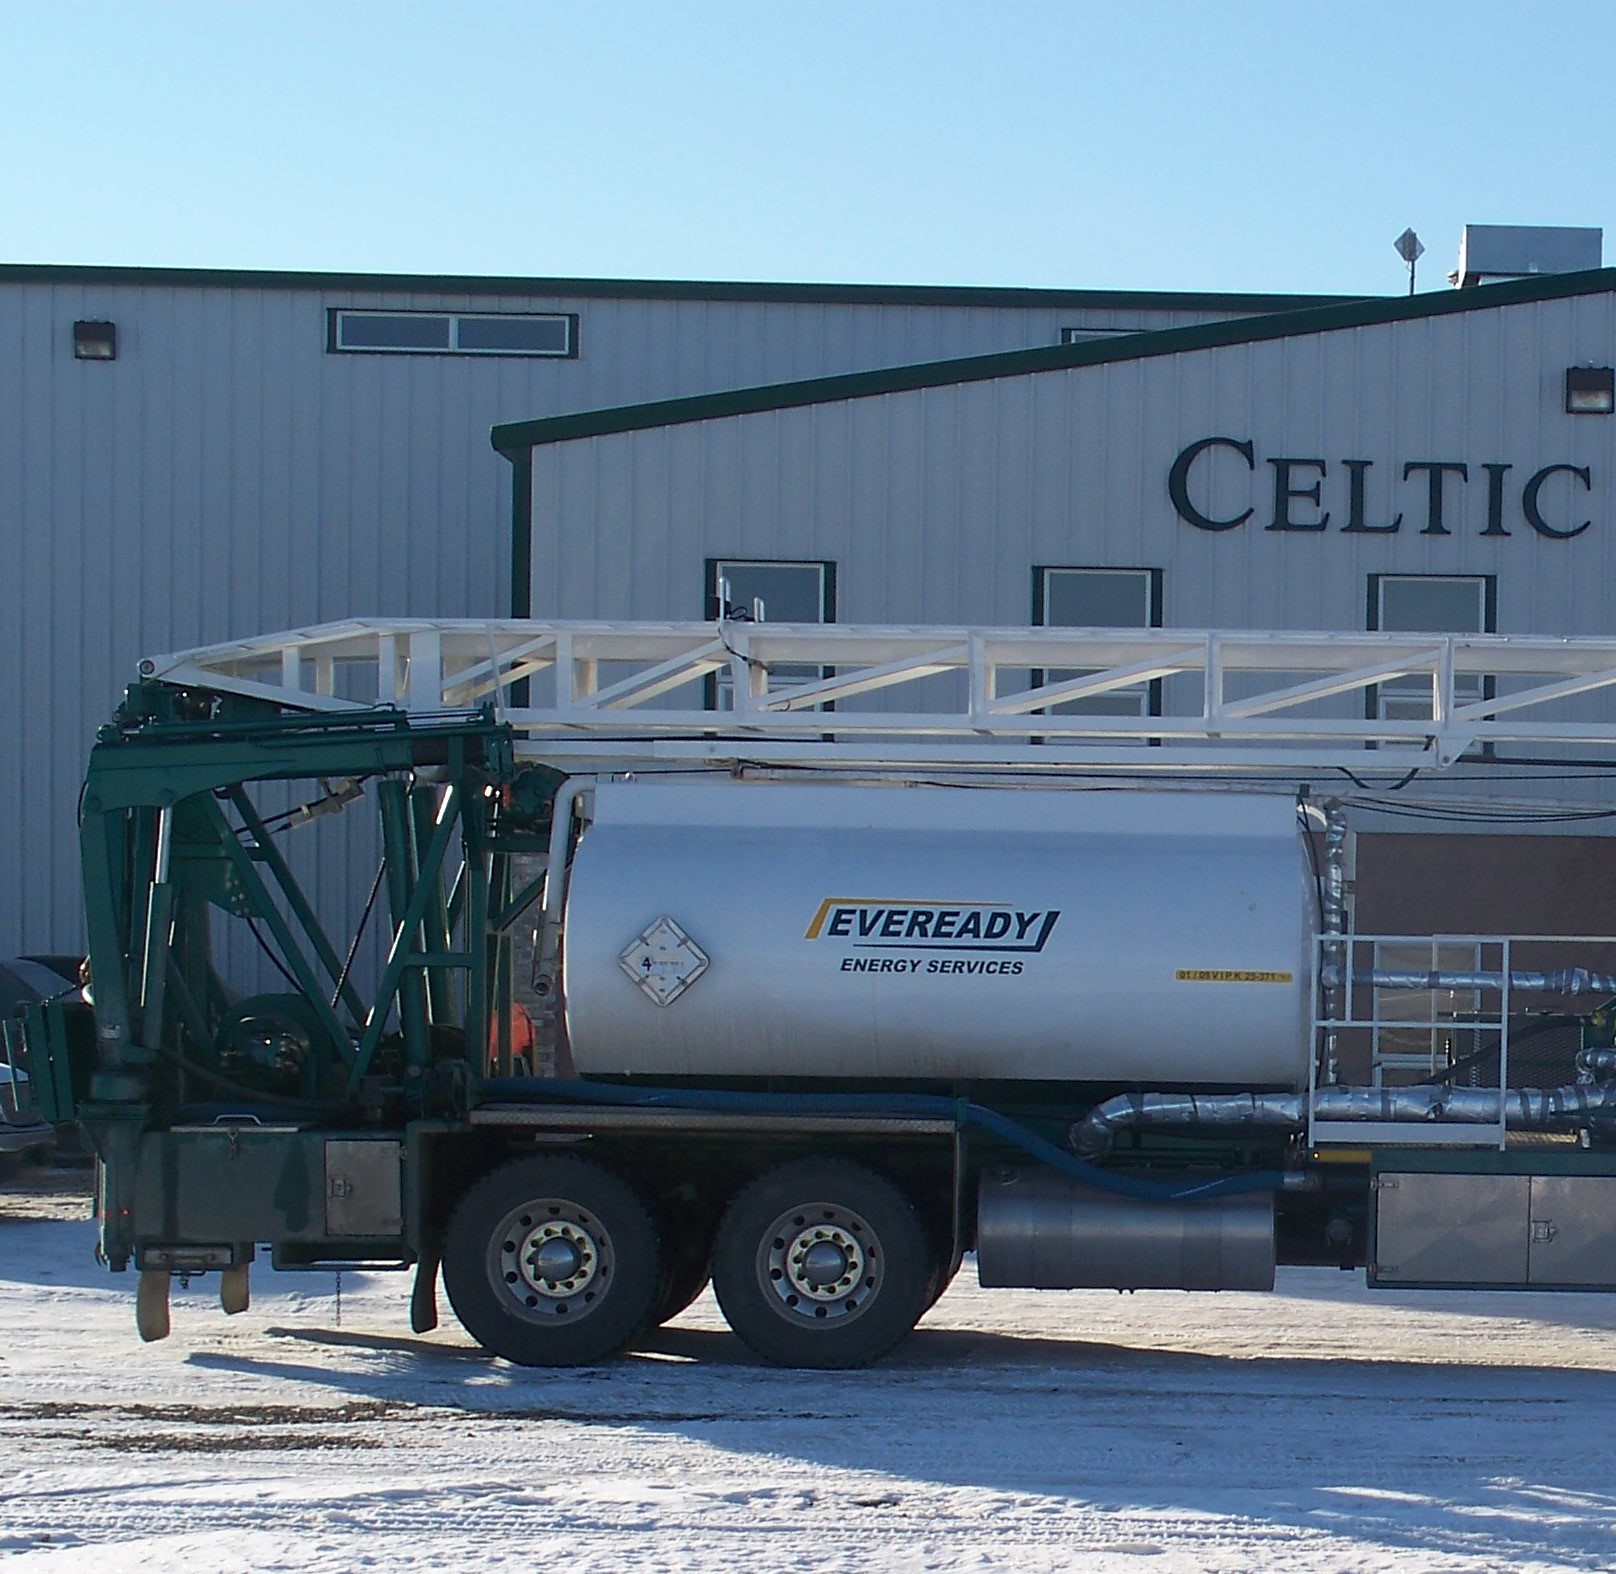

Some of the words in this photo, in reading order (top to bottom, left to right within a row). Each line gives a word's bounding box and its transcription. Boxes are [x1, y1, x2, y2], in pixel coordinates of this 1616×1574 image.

[1168, 436, 1591, 539] CELTIC
[827, 908, 1042, 940] EVEREADY
[840, 958, 922, 974] ENERGY
[926, 959, 1024, 975] SERVICES
